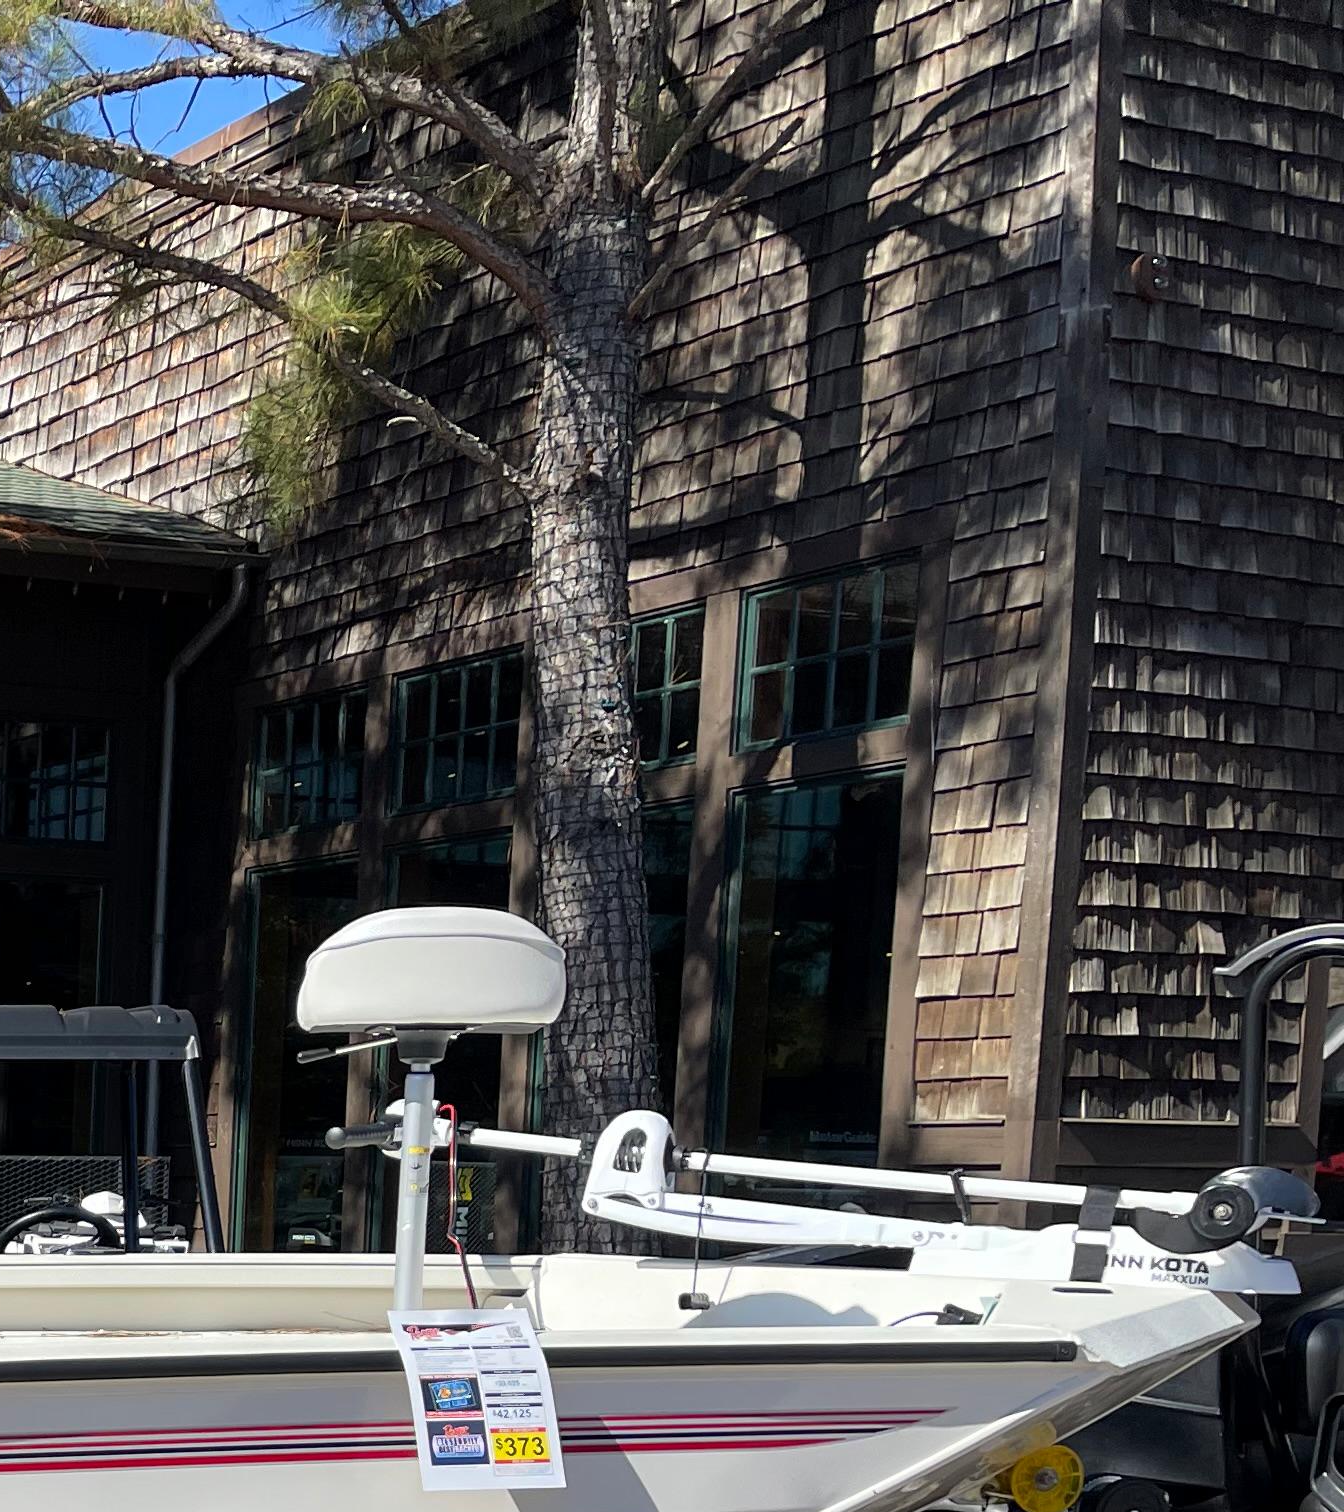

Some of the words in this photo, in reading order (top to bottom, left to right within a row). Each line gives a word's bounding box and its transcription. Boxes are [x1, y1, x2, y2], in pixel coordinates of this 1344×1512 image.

[1150, 1256, 1210, 1274] KOTA
[1151, 1272, 1210, 1286] MAXXUM
[495, 1436, 545, 1456] $373
